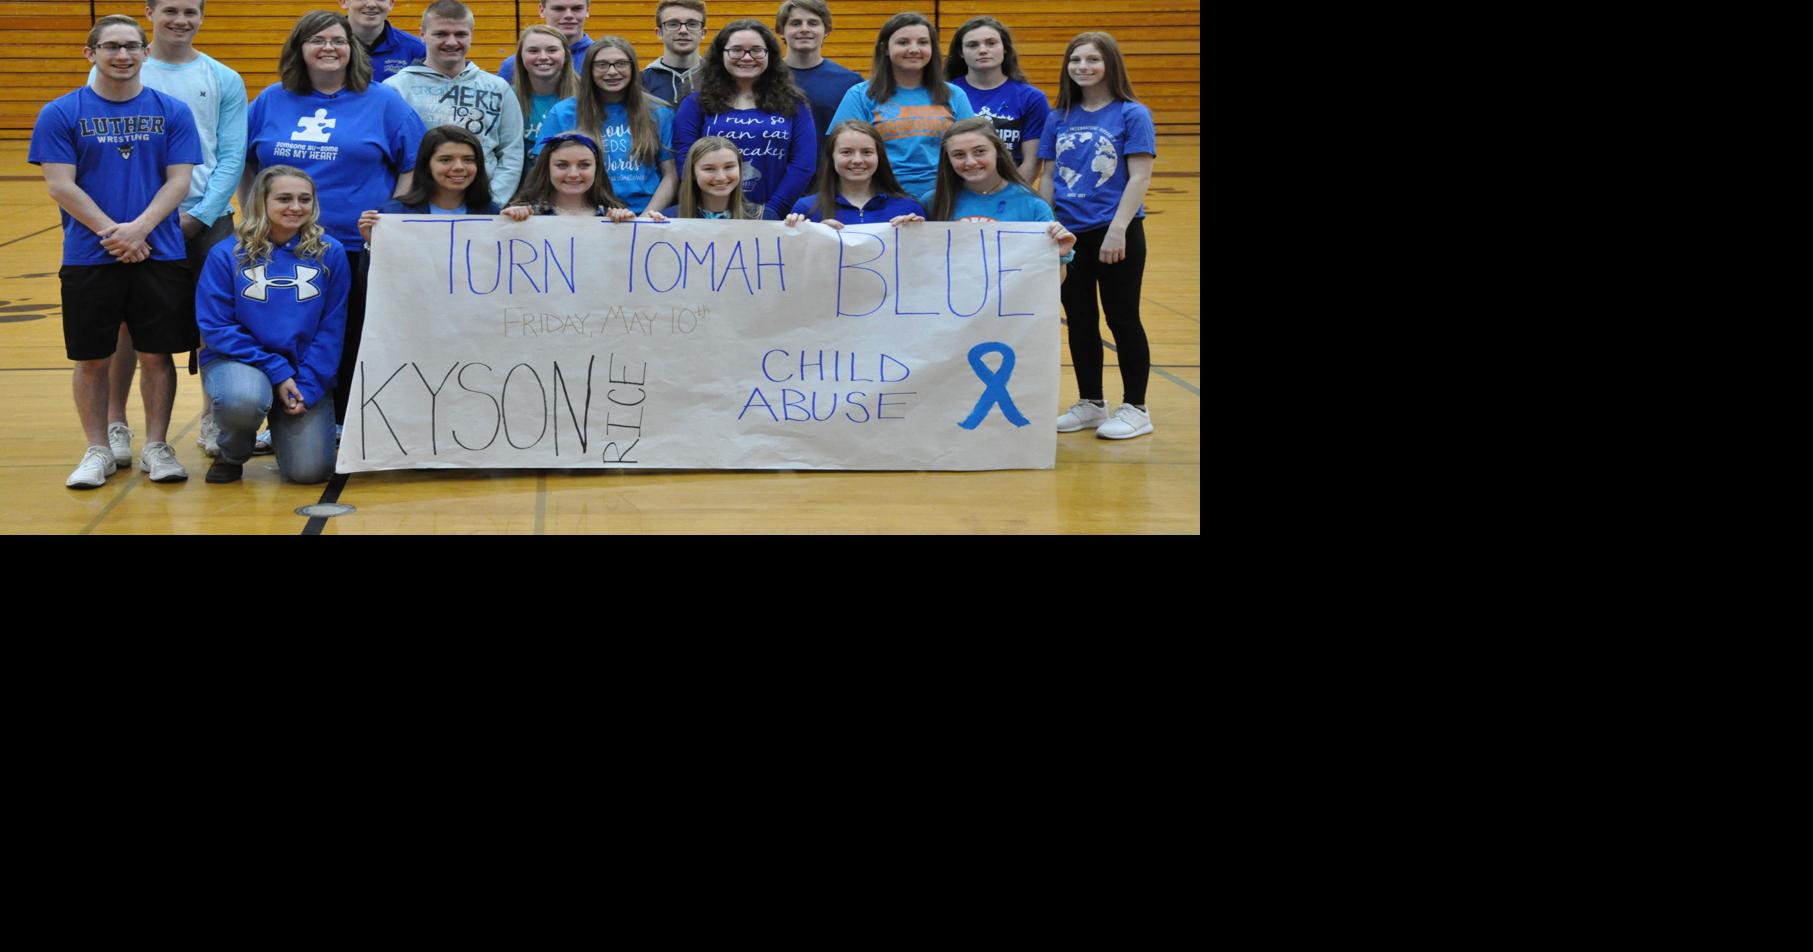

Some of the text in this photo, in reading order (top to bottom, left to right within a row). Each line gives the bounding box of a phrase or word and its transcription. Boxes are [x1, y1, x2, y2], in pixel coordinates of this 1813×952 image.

[438, 85, 503, 112] AERO
[79, 115, 165, 137] LUTHER
[452, 105, 500, 136] 1987
[717, 130, 756, 139] can
[762, 129, 789, 140] eat
[726, 116, 764, 125] run
[770, 115, 785, 125] so
[97, 133, 150, 143] WRESTLING
[273, 147, 339, 161] HAS MY HEART
[402, 218, 1046, 318] TURN TOMAH BLUE
[502, 304, 712, 338] FRIDAY, MAY 10th
[761, 349, 911, 383] CHILD
[360, 354, 596, 461] KYSON
[602, 352, 648, 465] RICE
[737, 386, 918, 424] ABUSE
